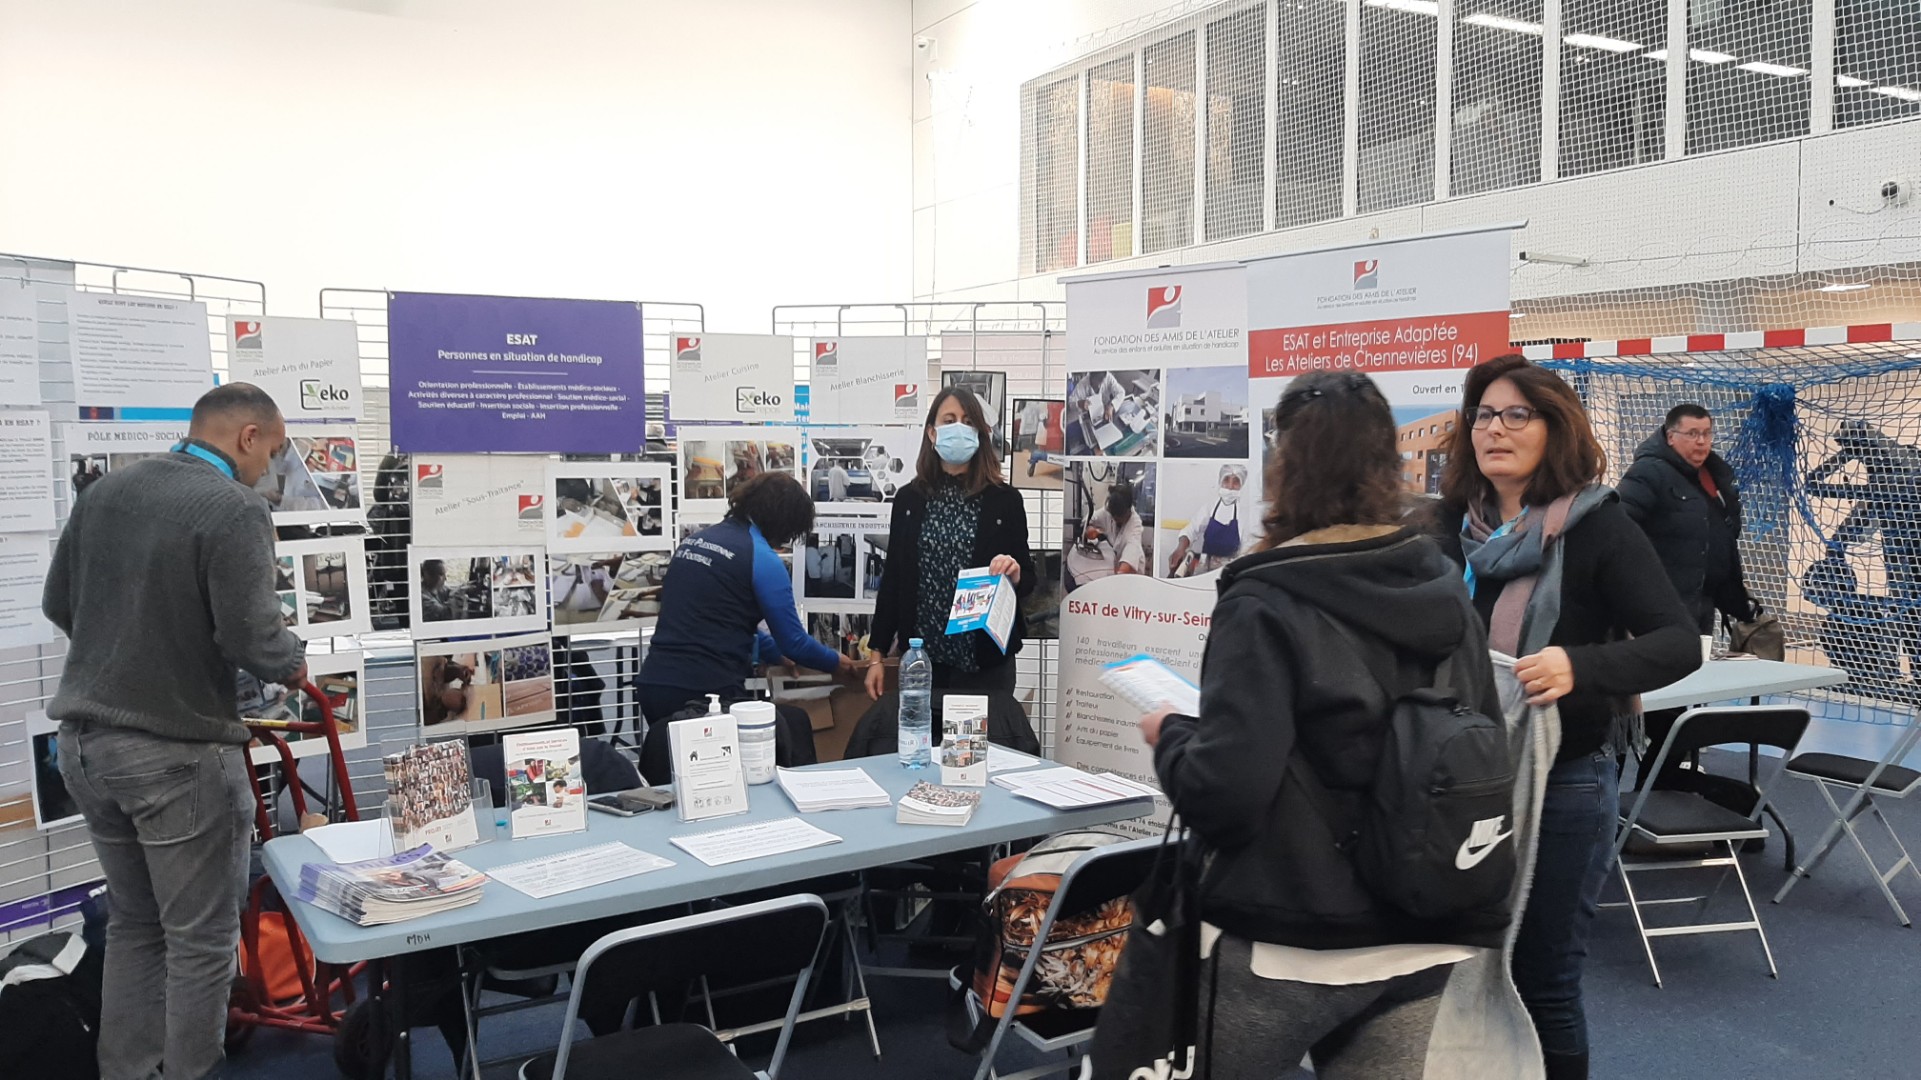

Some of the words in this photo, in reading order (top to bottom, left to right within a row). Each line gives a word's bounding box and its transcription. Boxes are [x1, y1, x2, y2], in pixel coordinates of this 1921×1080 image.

[507, 334, 538, 345] ESAT
[1094, 335, 1142, 346] FONDATION
[1145, 334, 1159, 342] DES
[1162, 332, 1183, 342] AMIS
[1186, 331, 1196, 340] DE
[1283, 333, 1309, 350] ESAT
[1313, 335, 1326, 348] et
[1330, 329, 1390, 352] Entreprise
[1394, 322, 1457, 346] Adaptée
[438, 350, 487, 360] Personnes
[490, 352, 501, 360] en
[503, 352, 545, 362] situation
[548, 353, 558, 362] de
[561, 353, 602, 366] handicap
[1266, 356, 1283, 372] Les
[1287, 353, 1331, 371] Ateliers
[1335, 354, 1351, 368] de
[1354, 346, 1447, 368] Chennevières
[1452, 343, 1478, 367] (94)
[254, 366, 279, 377] Atelier
[282, 364, 297, 373] Arts
[311, 359, 333, 369] Papier
[704, 370, 729, 382] Atelier
[732, 364, 759, 375] Cuisine
[461, 382, 512, 390] professionnelle
[830, 380, 854, 391] Atelier
[856, 369, 904, 385] Blanchisserie
[1413, 383, 1442, 394] Ouvert
[1445, 385, 1457, 394] en
[570, 403, 618, 411] professionnelle
[502, 412, 525, 420] Emploi
[88, 431, 111, 440] PÔLE
[435, 502, 460, 515] Atelier
[1068, 600, 1098, 616] ESAT
[1102, 604, 1119, 617] de
[1123, 606, 1212, 627] Vitry-sur-Sein
[1076, 636, 1090, 645] 140
[1097, 638, 1137, 650] travailleurs
[1145, 646, 1181, 656] exercent
[1076, 688, 1114, 700] Restauration
[1076, 700, 1098, 709] Traiteur
[1077, 712, 1114, 724] Blanchisserie
[1100, 729, 1118, 737] papier
[1124, 745, 1139, 754] livres
[1077, 761, 1089, 770] Des
[407, 934, 430, 945] MDH
